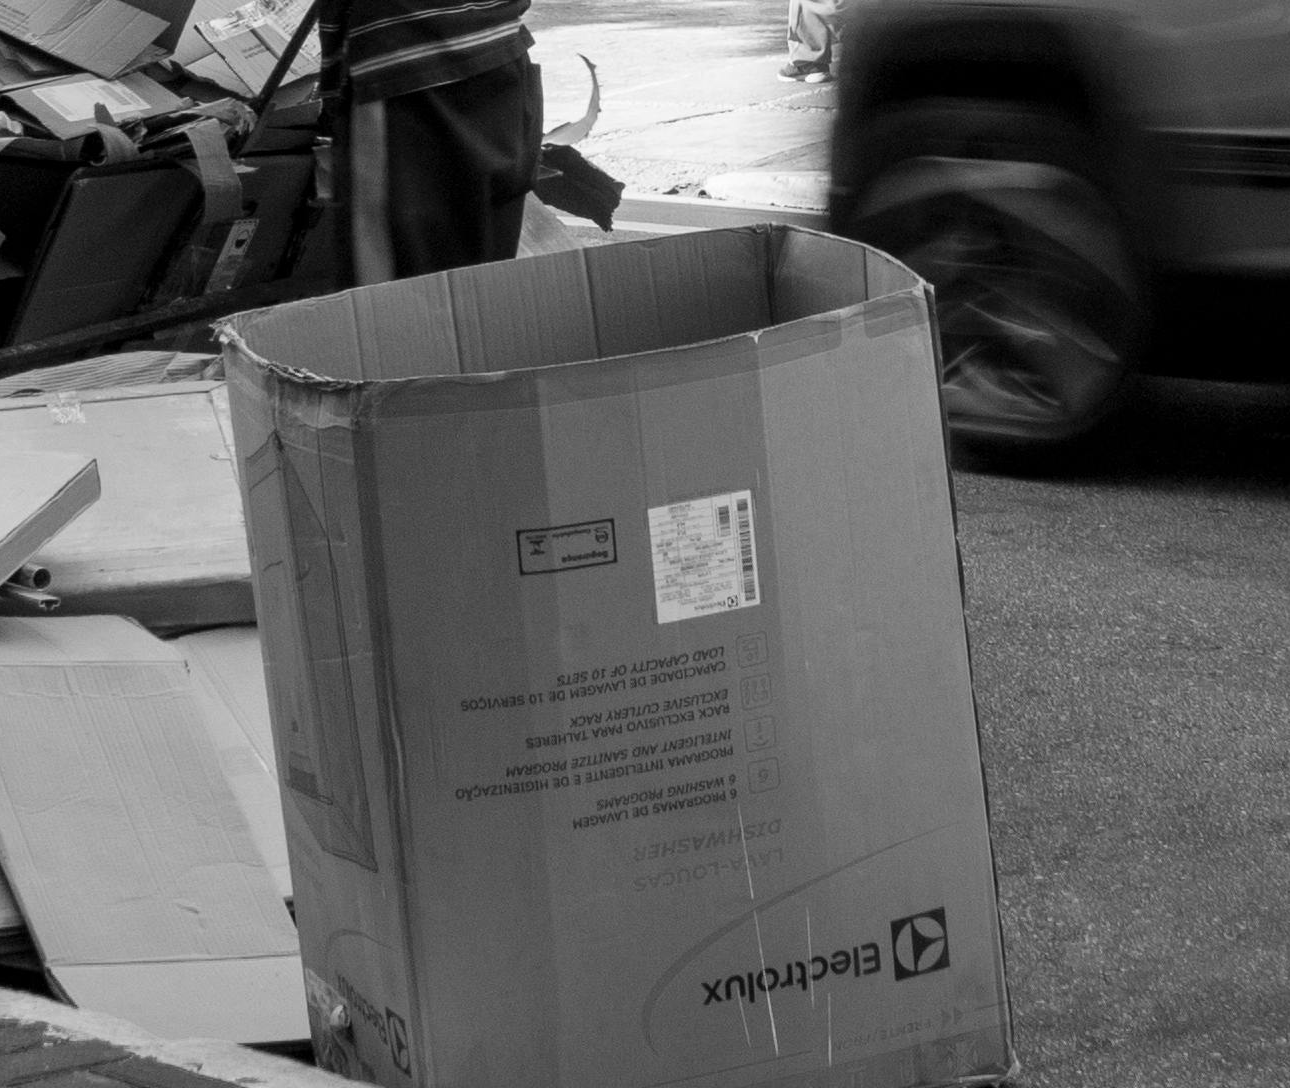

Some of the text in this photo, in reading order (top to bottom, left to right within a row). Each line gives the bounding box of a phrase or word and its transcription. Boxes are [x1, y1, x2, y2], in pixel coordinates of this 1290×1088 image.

[555, 645, 725, 687] LOAD CAPACITY OF 10 SETS
[460, 660, 726, 712] CAPACIDADE DE LAVAGEM DE 10 SERVIÇOS
[524, 703, 730, 750] RACK EXCLUSIVO PARA TALHERES
[568, 689, 729, 728] EXCLUSIVE CUTLERY RACK
[504, 728, 732, 777] INTELIGENT AND SANITIZE PROGRAM
[584, 758, 664, 782] INTELIGENTE
[667, 745, 734, 767] PROGRAMA
[454, 777, 549, 802] HIGIENIZAÇÃO
[552, 775, 569, 788] DE
[595, 773, 737, 810] 6 WASHING PROGRAMS
[571, 787, 738, 829] 6 PROGRAMAS DE LAVAGEM
[631, 820, 782, 859] DISHWASHER
[700, 941, 882, 1008] Electrolux
